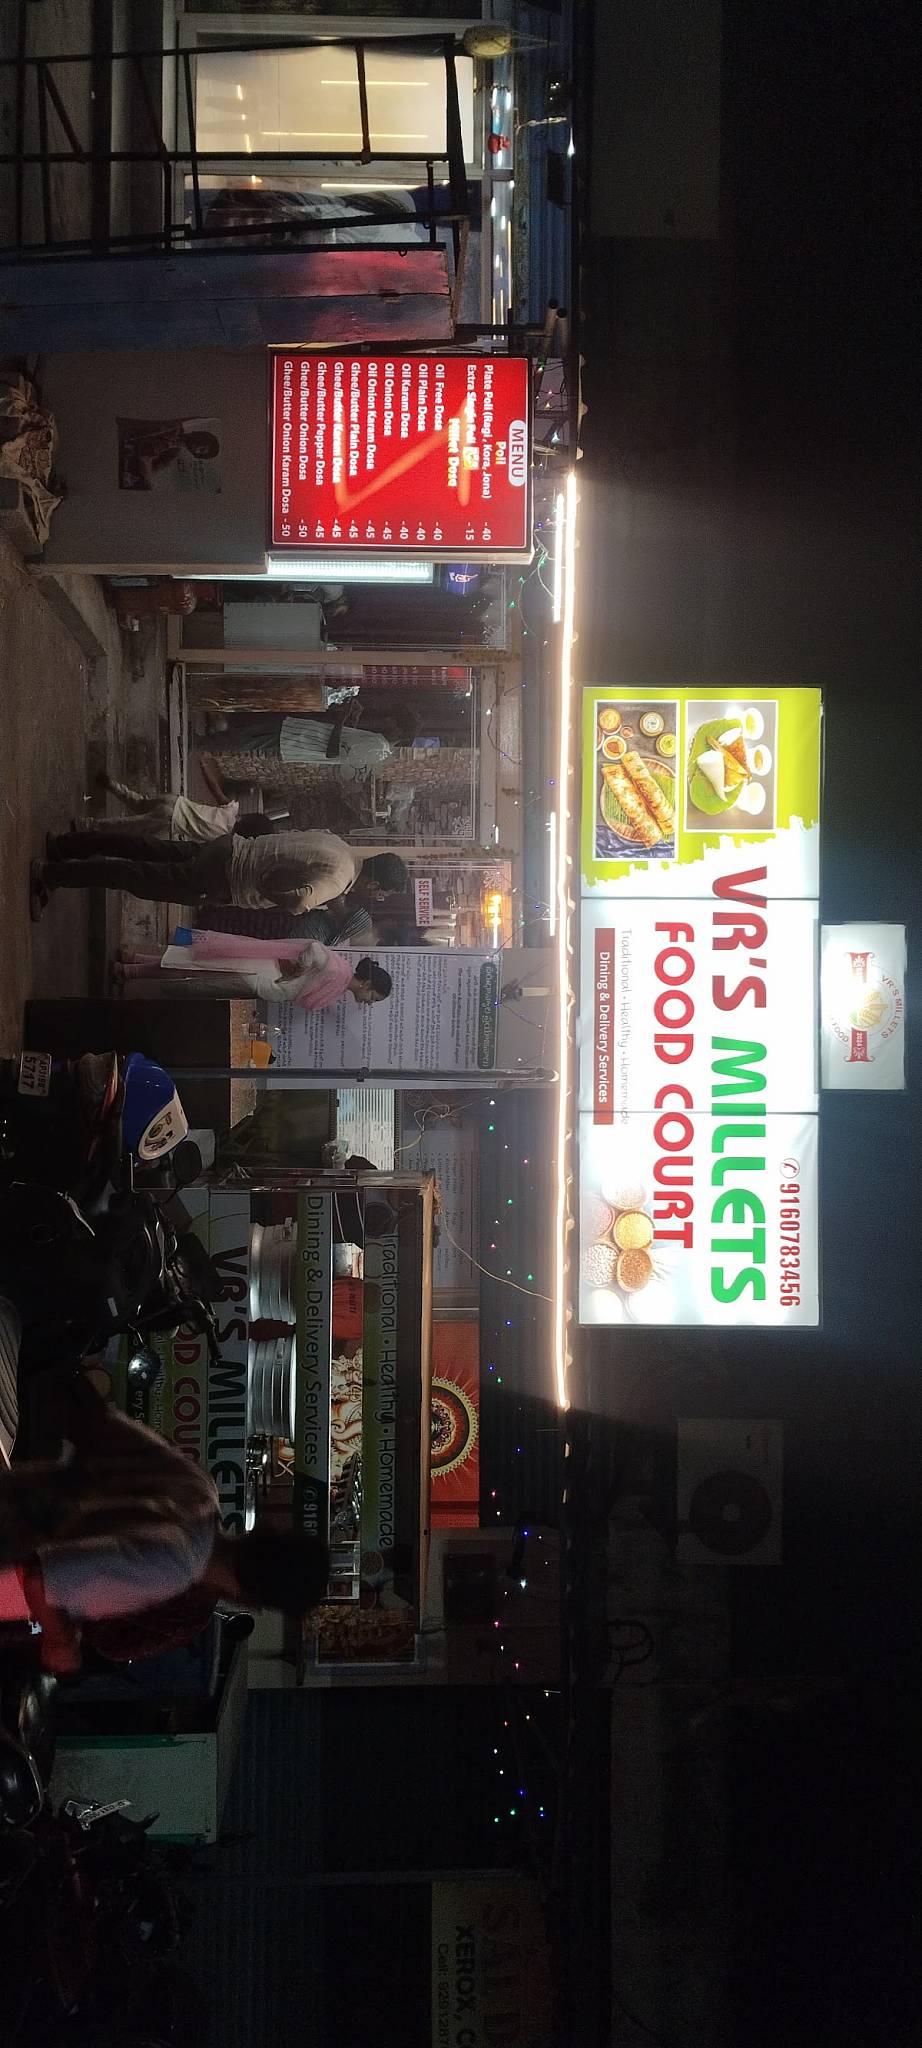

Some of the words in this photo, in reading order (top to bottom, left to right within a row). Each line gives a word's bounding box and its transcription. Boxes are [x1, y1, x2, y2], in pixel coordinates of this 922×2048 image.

[368, 362, 377, 376] Oil
[385, 363, 394, 377] Oil
[402, 363, 411, 377] Oil
[418, 364, 428, 377] Oil
[435, 364, 444, 378] Oil
[466, 364, 476, 390] Extra
[483, 364, 492, 390] Plate
[283, 361, 293, 421] Ghee/Butter
[300, 362, 309, 421] Ghee/Butter
[316, 362, 327, 422] Ghee/Butter
[333, 362, 343, 422] Ghee/Butter
[350, 362, 360, 422] Ghee/Butter
[367, 379, 376, 408] Onion
[384, 379, 394, 409] Onion
[401, 379, 411, 411] Karam
[418, 379, 428, 404] Plain
[435, 382, 444, 404] Free
[483, 391, 492, 410] Poli
[417, 406, 427, 432] Dosa
[434, 406, 444, 431] Dosa
[464, 392, 476, 422] Single
[282, 423, 292, 453] Onion
[299, 423, 308, 453] Onion
[350, 424, 360, 449] Plain
[367, 411, 376, 442] Karam
[384, 411, 393, 436] Dosa
[401, 413, 410, 438] Dosa
[448, 418, 460, 453] Millet
[466, 424, 476, 444] Poli
[314, 424, 326, 458] Pepper
[333, 424, 342, 455] Karam
[496, 441, 506, 464] Poli
[512, 428, 524, 478] MENU
[282, 455, 291, 487] Karam
[299, 456, 308, 480] Dosa
[332, 457, 342, 483] Dosa
[349, 451, 359, 476] Dosa
[366, 444, 376, 470] Dosa
[448, 456, 458, 486] Dosa
[482, 444, 492, 470] Kora,
[316, 460, 325, 485] Dosa
[481, 471, 492, 498] Jona)
[282, 489, 291, 513] Dosa
[418, 880, 430, 896] SELF
[418, 898, 430, 924] SERVICE
[711, 866, 768, 1012] VR'S
[596, 952, 610, 990] Dining
[620, 929, 632, 992] Traditional
[598, 992, 610, 1002] &
[653, 922, 695, 1065] FOOD
[880, 975, 900, 996] VR'S
[596, 1004, 610, 1052] Delivery
[616, 1002, 632, 1048] Healthy
[880, 998, 902, 1039] MILLETS
[21, 1056, 36, 1089] 5717
[598, 1054, 610, 1103] Services
[620, 1057, 632, 1126] Homemade
[652, 1084, 694, 1249] COURT
[710, 1036, 768, 1304] MILLETS
[302, 1196, 324, 1262] Dining
[779, 1183, 801, 1307] 9160783456
[306, 1268, 322, 1283] &
[380, 1234, 400, 1334] Traditional
[300, 1289, 324, 1376] Delivery
[374, 1349, 400, 1424] Healthy
[304, 1380, 322, 1465] Services
[378, 1439, 398, 1546] Homemade
[453, 1924, 476, 2021] XEROX,
[437, 1981, 449, 2048] 9291287
[456, 2028, 476, 2048] C
